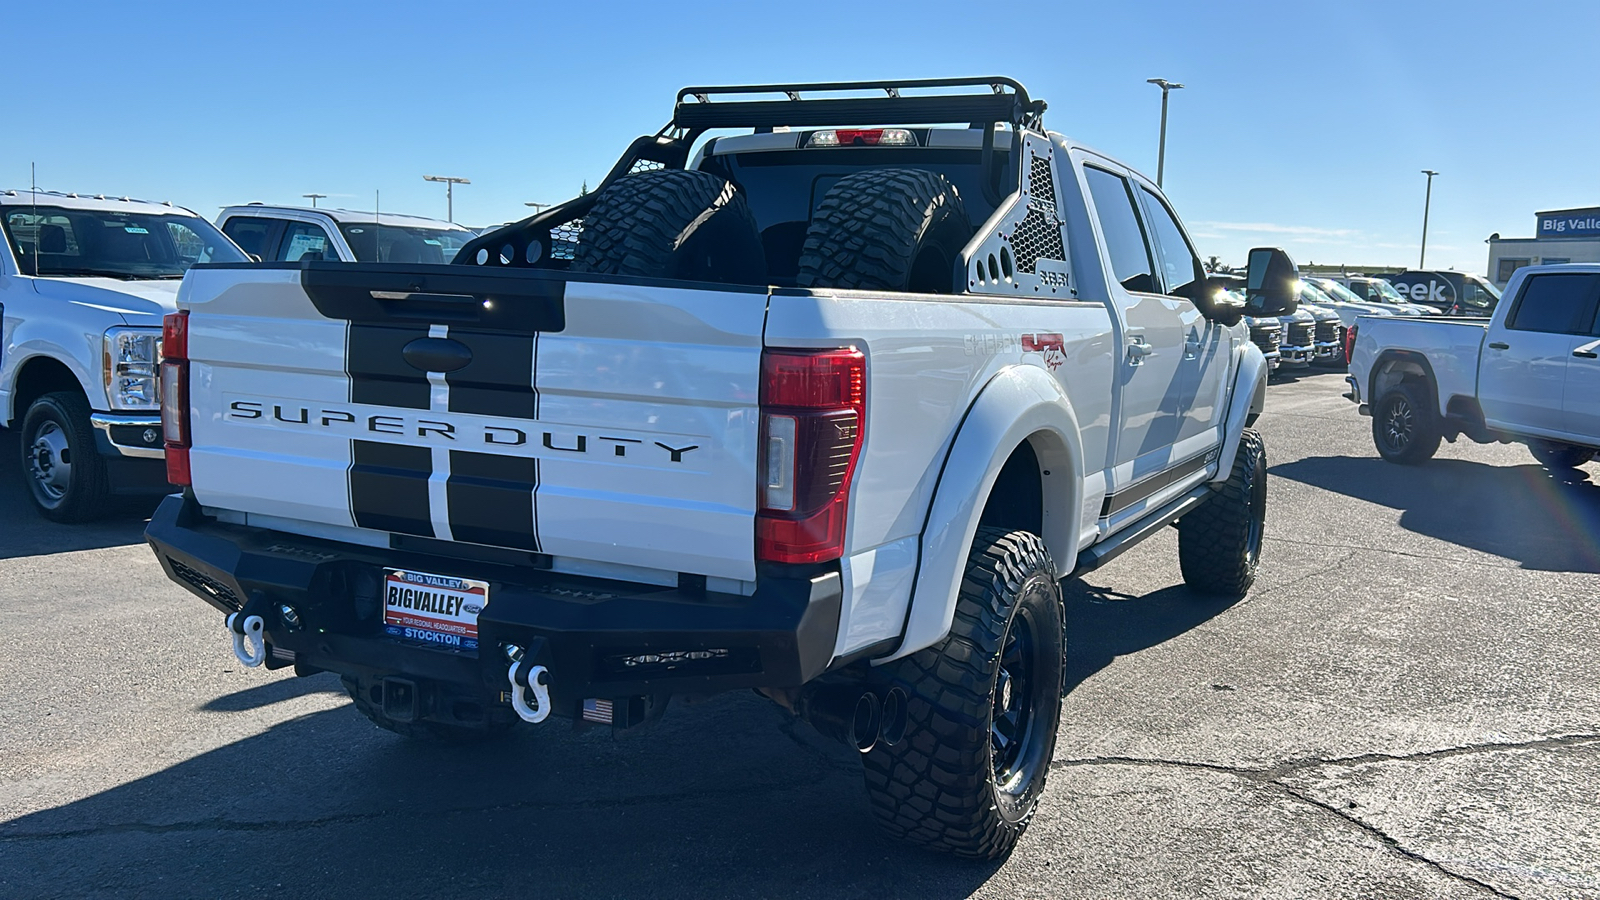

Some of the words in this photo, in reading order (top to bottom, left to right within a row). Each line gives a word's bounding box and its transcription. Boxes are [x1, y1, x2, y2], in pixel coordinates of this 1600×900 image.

[1543, 219, 1565, 232] Big
[1384, 278, 1447, 302] eek
[963, 333, 1021, 356] SHELBY
[231, 400, 456, 440] SUPER
[484, 425, 699, 463] DUTY
[407, 573, 423, 583] BIG
[426, 576, 461, 588] VALLEY
[388, 586, 464, 617] BIGVALLEY
[414, 619, 433, 628] REGIONAL
[434, 622, 466, 633] HEADQUARTERS
[405, 628, 460, 645] STOCKTON
